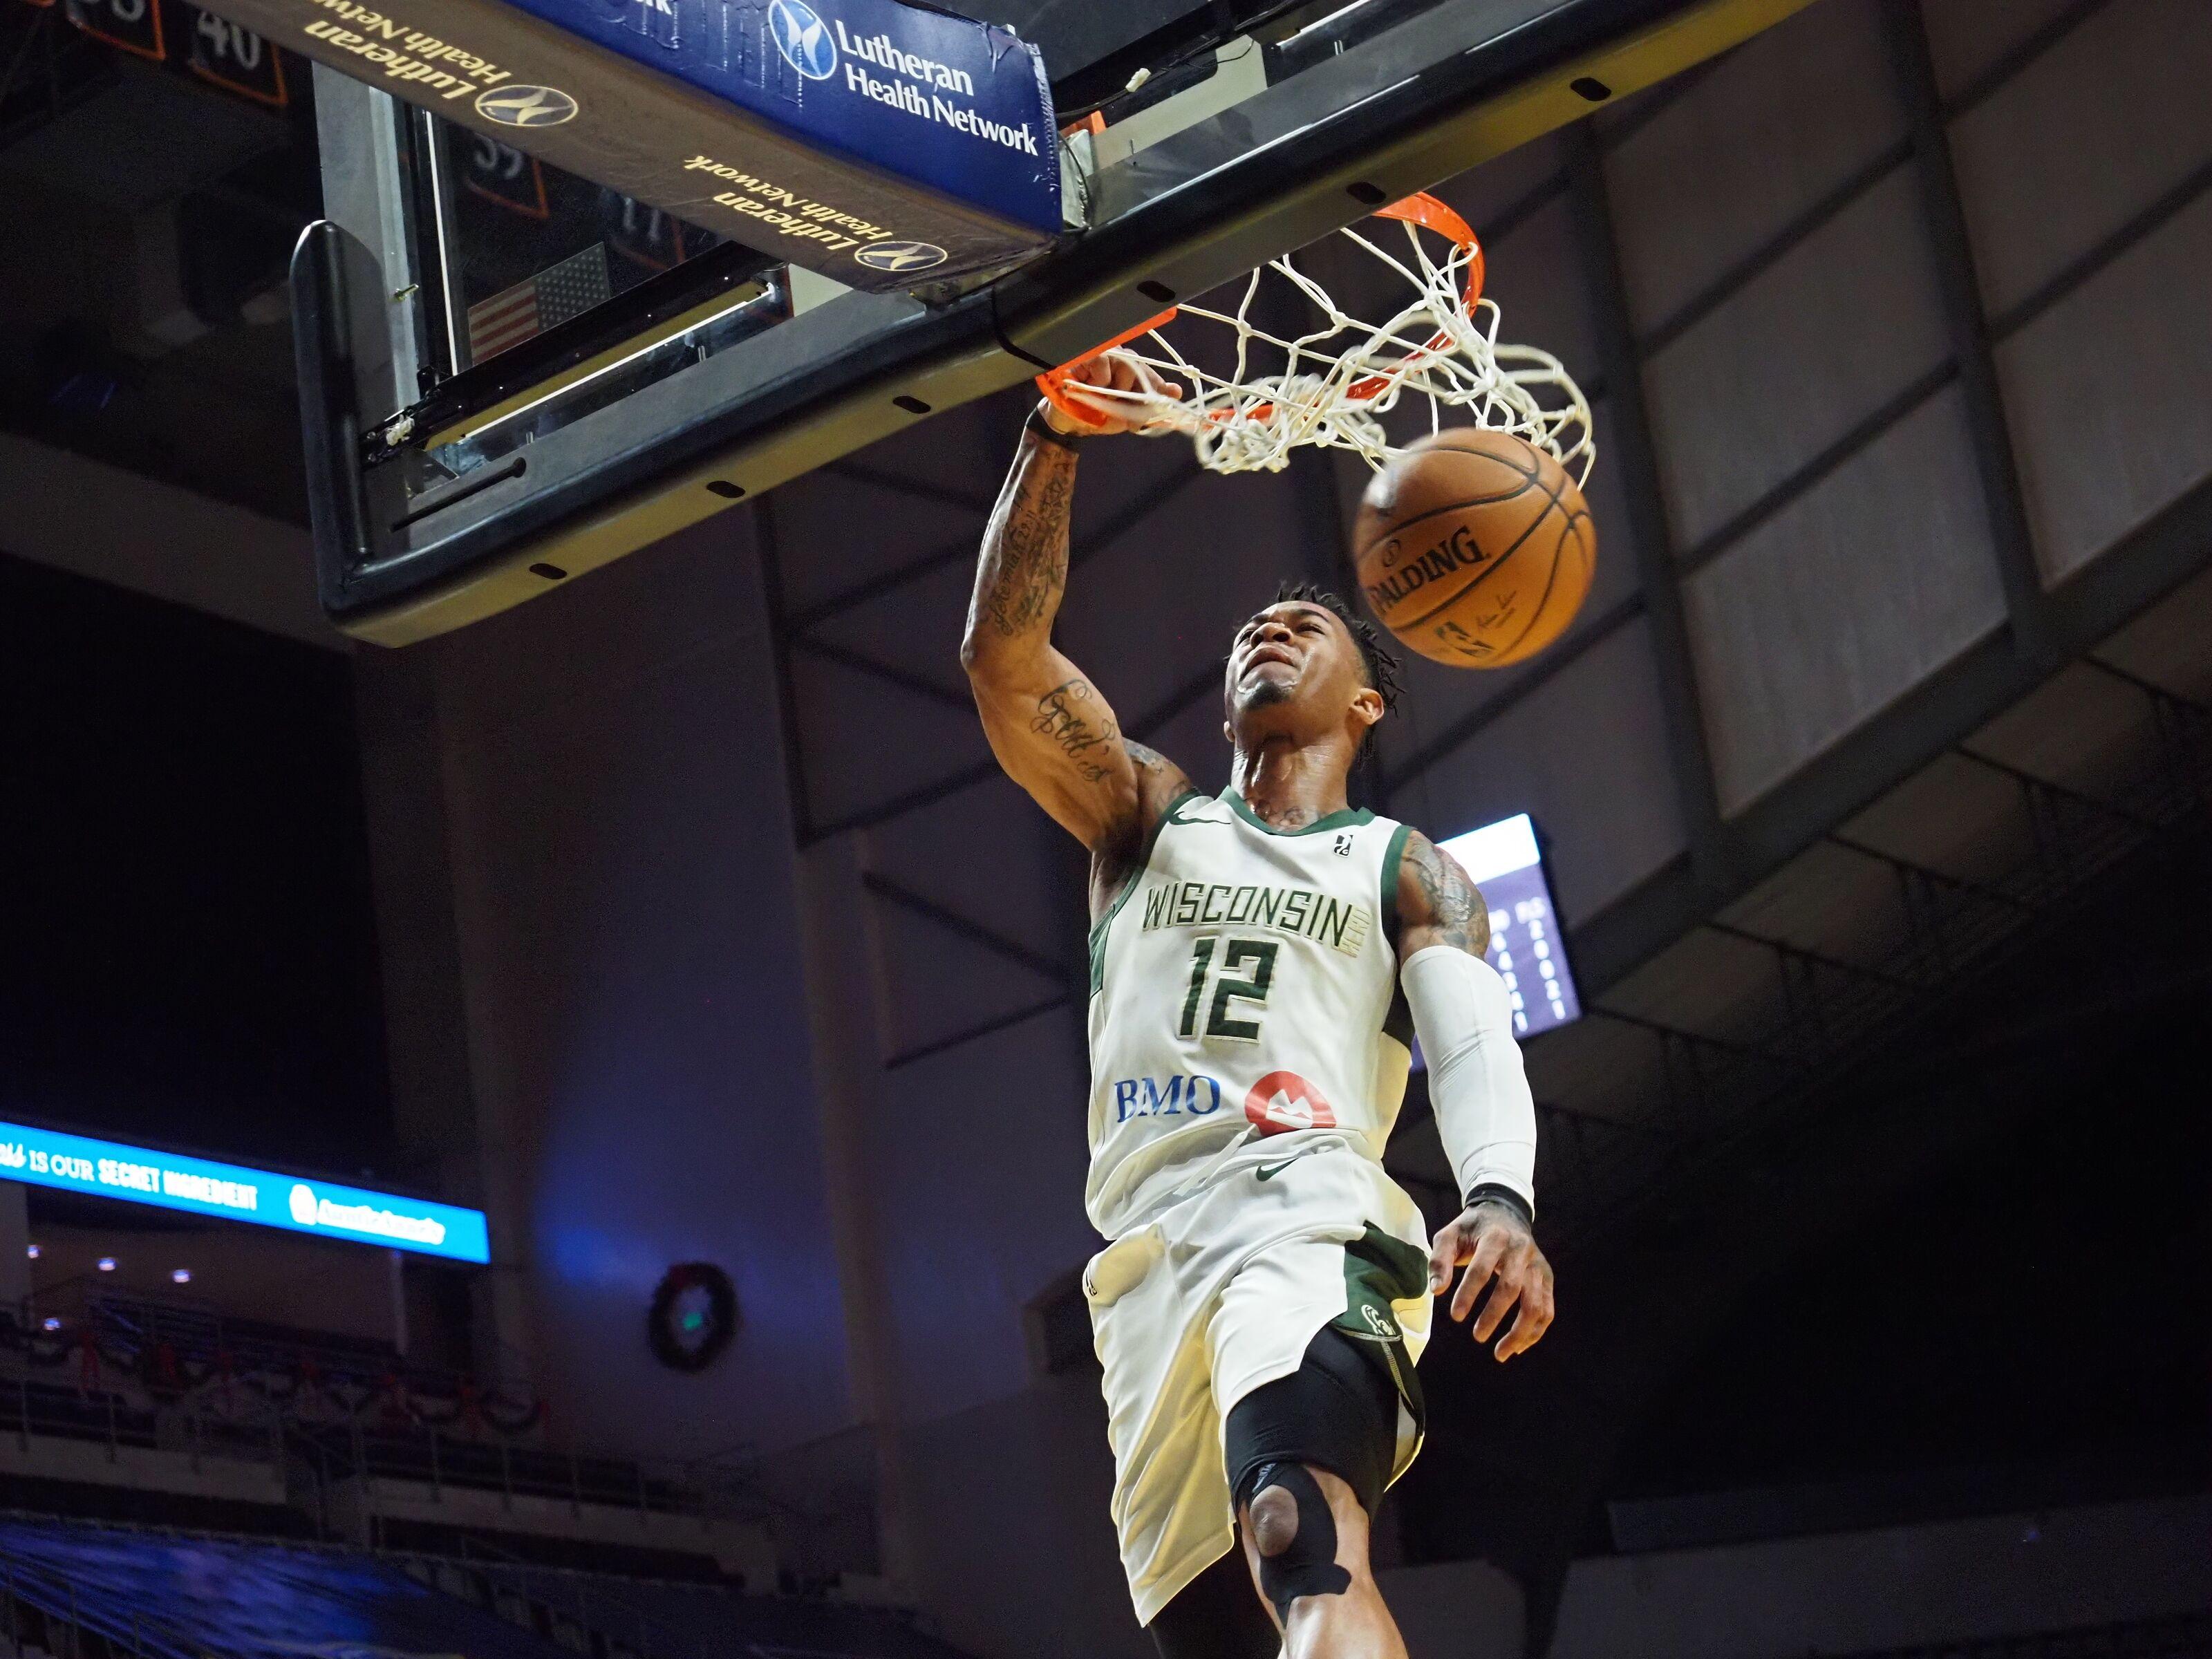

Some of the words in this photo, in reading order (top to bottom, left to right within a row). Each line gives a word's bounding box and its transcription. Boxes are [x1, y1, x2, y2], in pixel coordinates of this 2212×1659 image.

[313, 0, 411, 40] Netw
[304, 20, 478, 100] Lutheran
[404, 32, 512, 84] Health
[834, 19, 975, 96] Lutheran
[845, 63, 930, 117] Health
[932, 94, 1039, 157] Network
[683, 155, 809, 209] Network
[713, 191, 860, 250] Lutheran
[801, 203, 893, 241] Health
[1142, 880, 1353, 951] WISCONSIN
[1177, 937, 1281, 1042] 12
[1114, 1075, 1221, 1123] BMO
[29, 1150, 48, 1173] IS
[50, 1154, 95, 1181] OUR
[97, 1158, 160, 1193] SECRET
